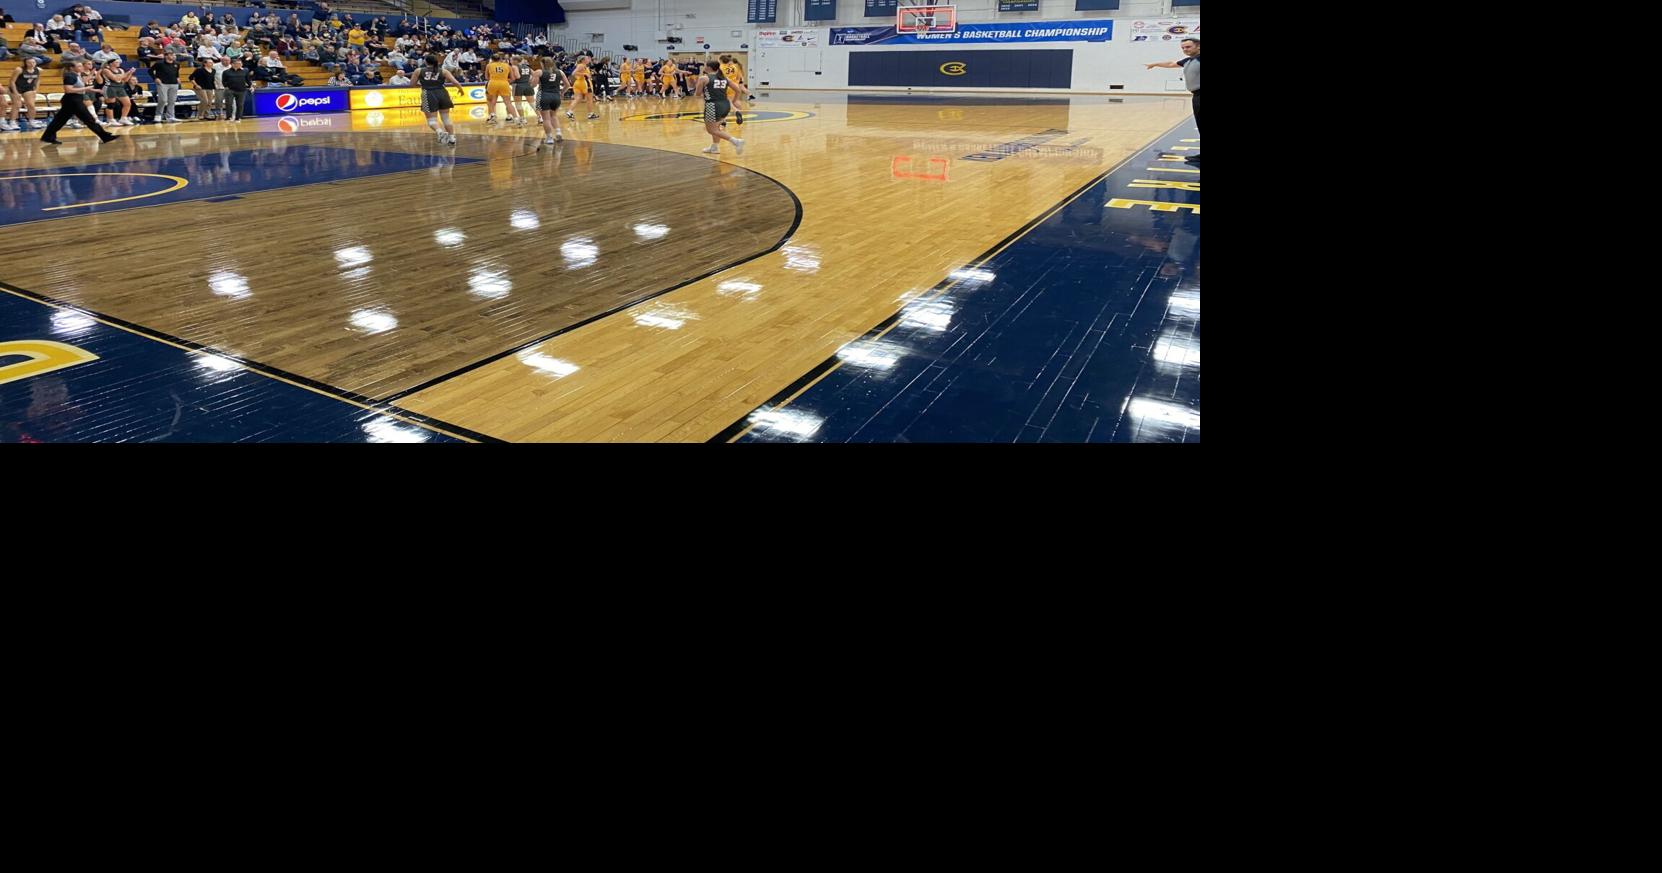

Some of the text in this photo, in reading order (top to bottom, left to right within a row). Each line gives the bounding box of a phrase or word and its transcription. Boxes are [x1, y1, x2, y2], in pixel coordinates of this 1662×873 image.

[916, 27, 1108, 39] WOMENS BASKETBALL CHAMPIONSHIP
[495, 66, 504, 74] 15
[548, 73, 557, 82] 3
[713, 79, 728, 89] 23
[299, 96, 331, 107] pepsi
